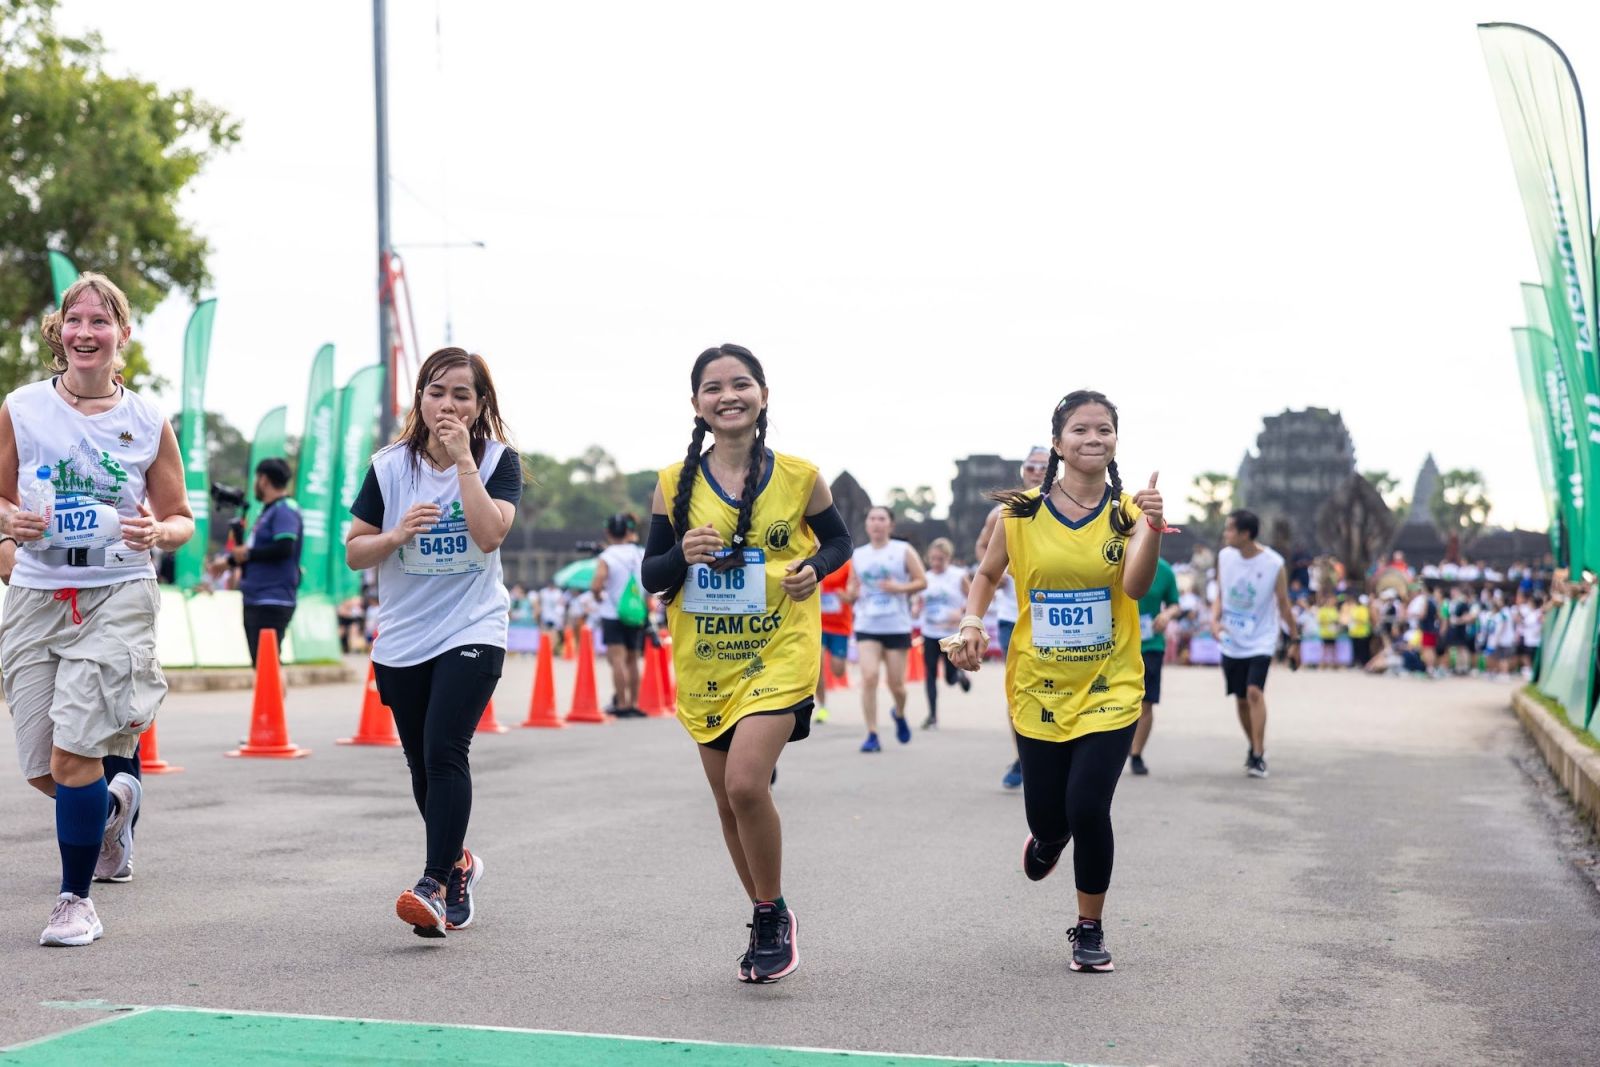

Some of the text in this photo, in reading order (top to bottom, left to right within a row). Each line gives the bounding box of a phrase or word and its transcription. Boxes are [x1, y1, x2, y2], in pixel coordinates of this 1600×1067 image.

[305, 404, 332, 495] Manulife
[420, 535, 467, 555] 5439
[697, 567, 745, 590] 6618
[694, 610, 782, 635] TEAM CCF
[1048, 606, 1093, 626] 6621
[716, 638, 771, 651] CAMBOD
[1056, 642, 1116, 653] CAMBODIA
[717, 651, 760, 661] CHILDREN'
[1056, 653, 1100, 662] CHILDREN'S
